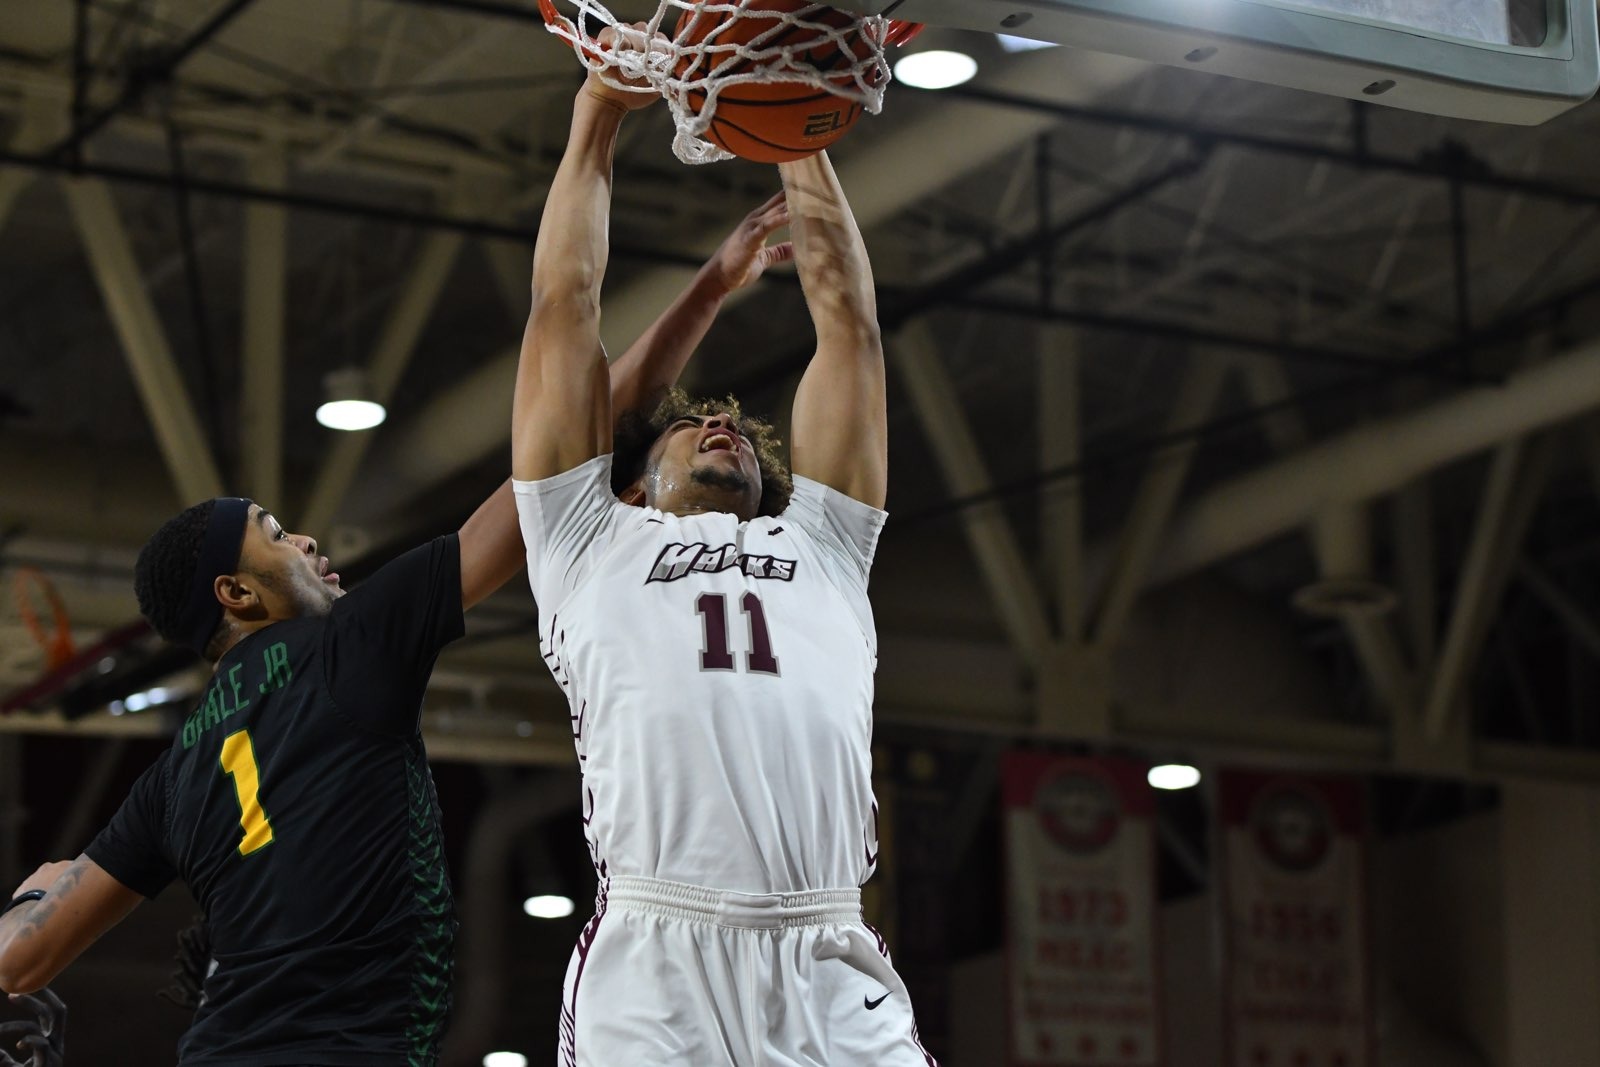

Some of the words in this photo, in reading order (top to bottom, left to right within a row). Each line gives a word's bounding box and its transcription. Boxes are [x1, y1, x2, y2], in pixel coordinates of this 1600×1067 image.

[258, 641, 292, 695] JR
[694, 589, 781, 677] 11
[219, 728, 275, 857] 1
